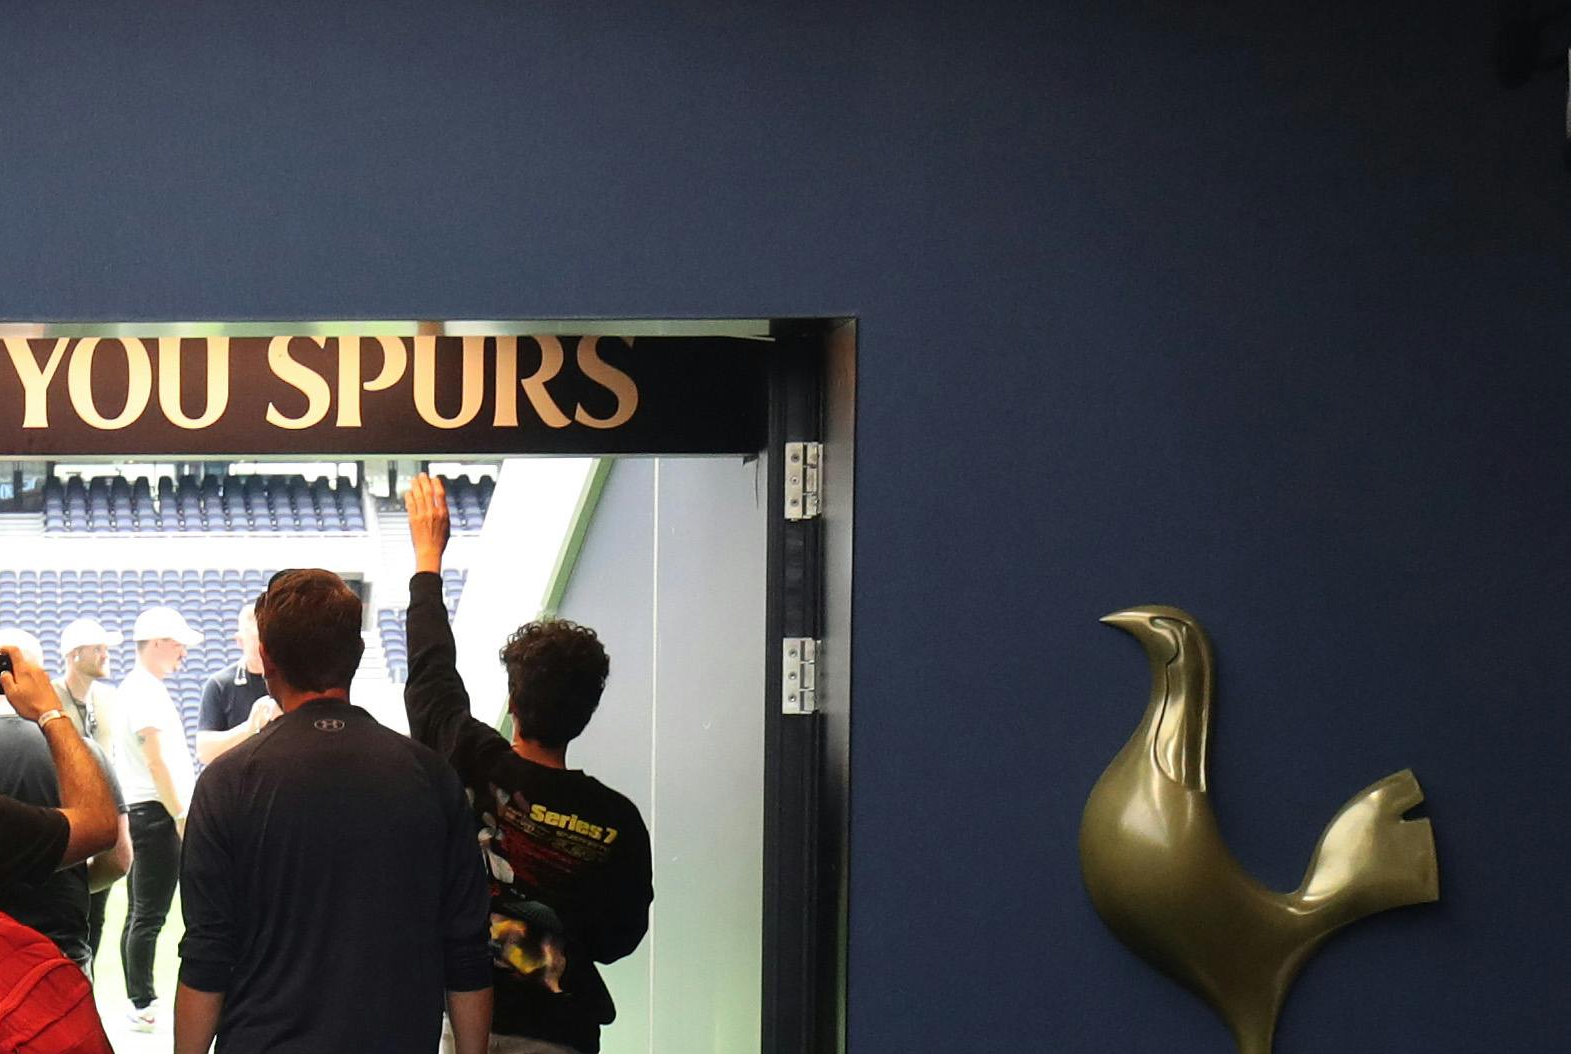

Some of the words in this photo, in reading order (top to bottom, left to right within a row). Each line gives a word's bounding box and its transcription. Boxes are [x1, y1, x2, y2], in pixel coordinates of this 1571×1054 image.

[1, 337, 230, 430] YOU
[265, 335, 639, 430] SPURS
[529, 803, 604, 841] Series
